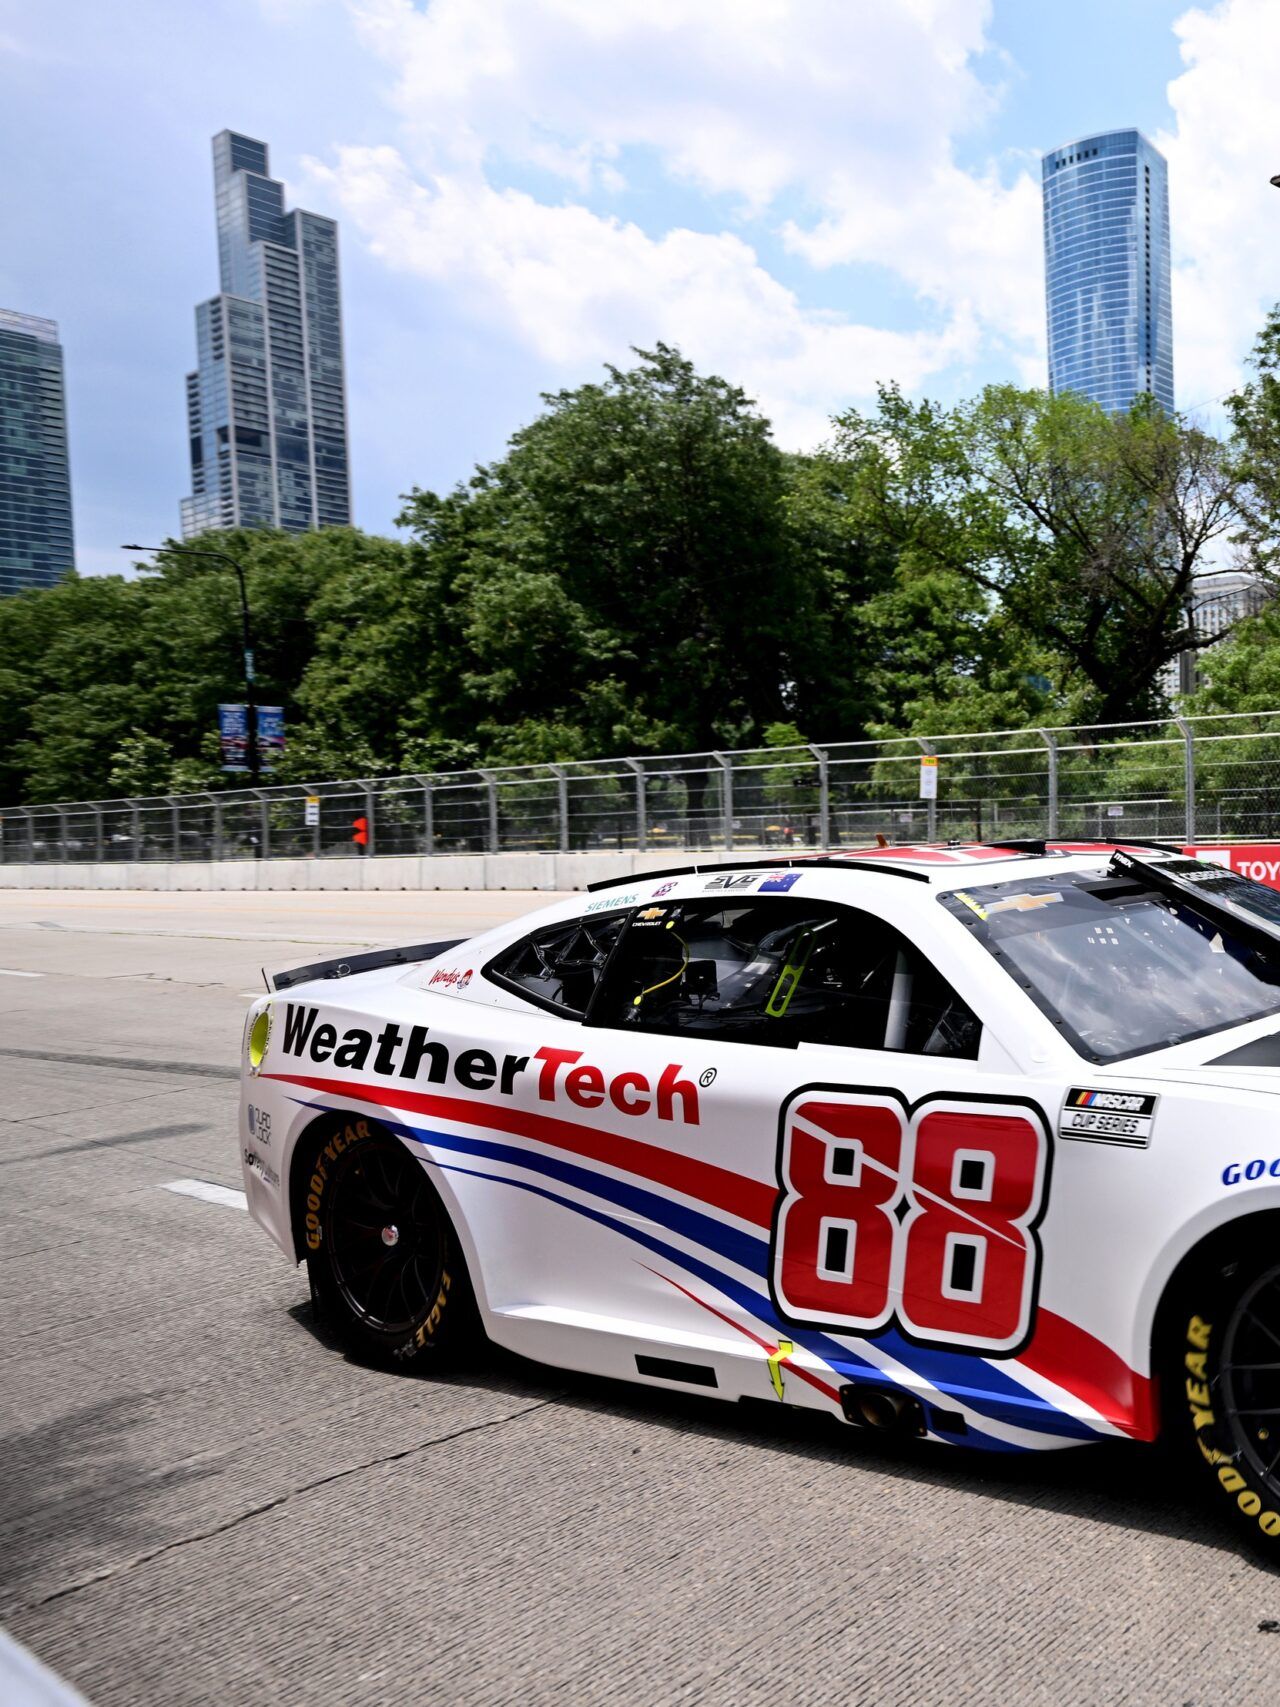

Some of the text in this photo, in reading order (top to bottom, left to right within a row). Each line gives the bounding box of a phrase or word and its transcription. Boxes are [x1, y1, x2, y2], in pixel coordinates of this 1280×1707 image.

[585, 893, 638, 913] SIEMENS
[1092, 1093, 1146, 1112] NASCAR
[1072, 1113, 1140, 1134] CUP SERIES
[767, 1082, 1055, 1360] 88
